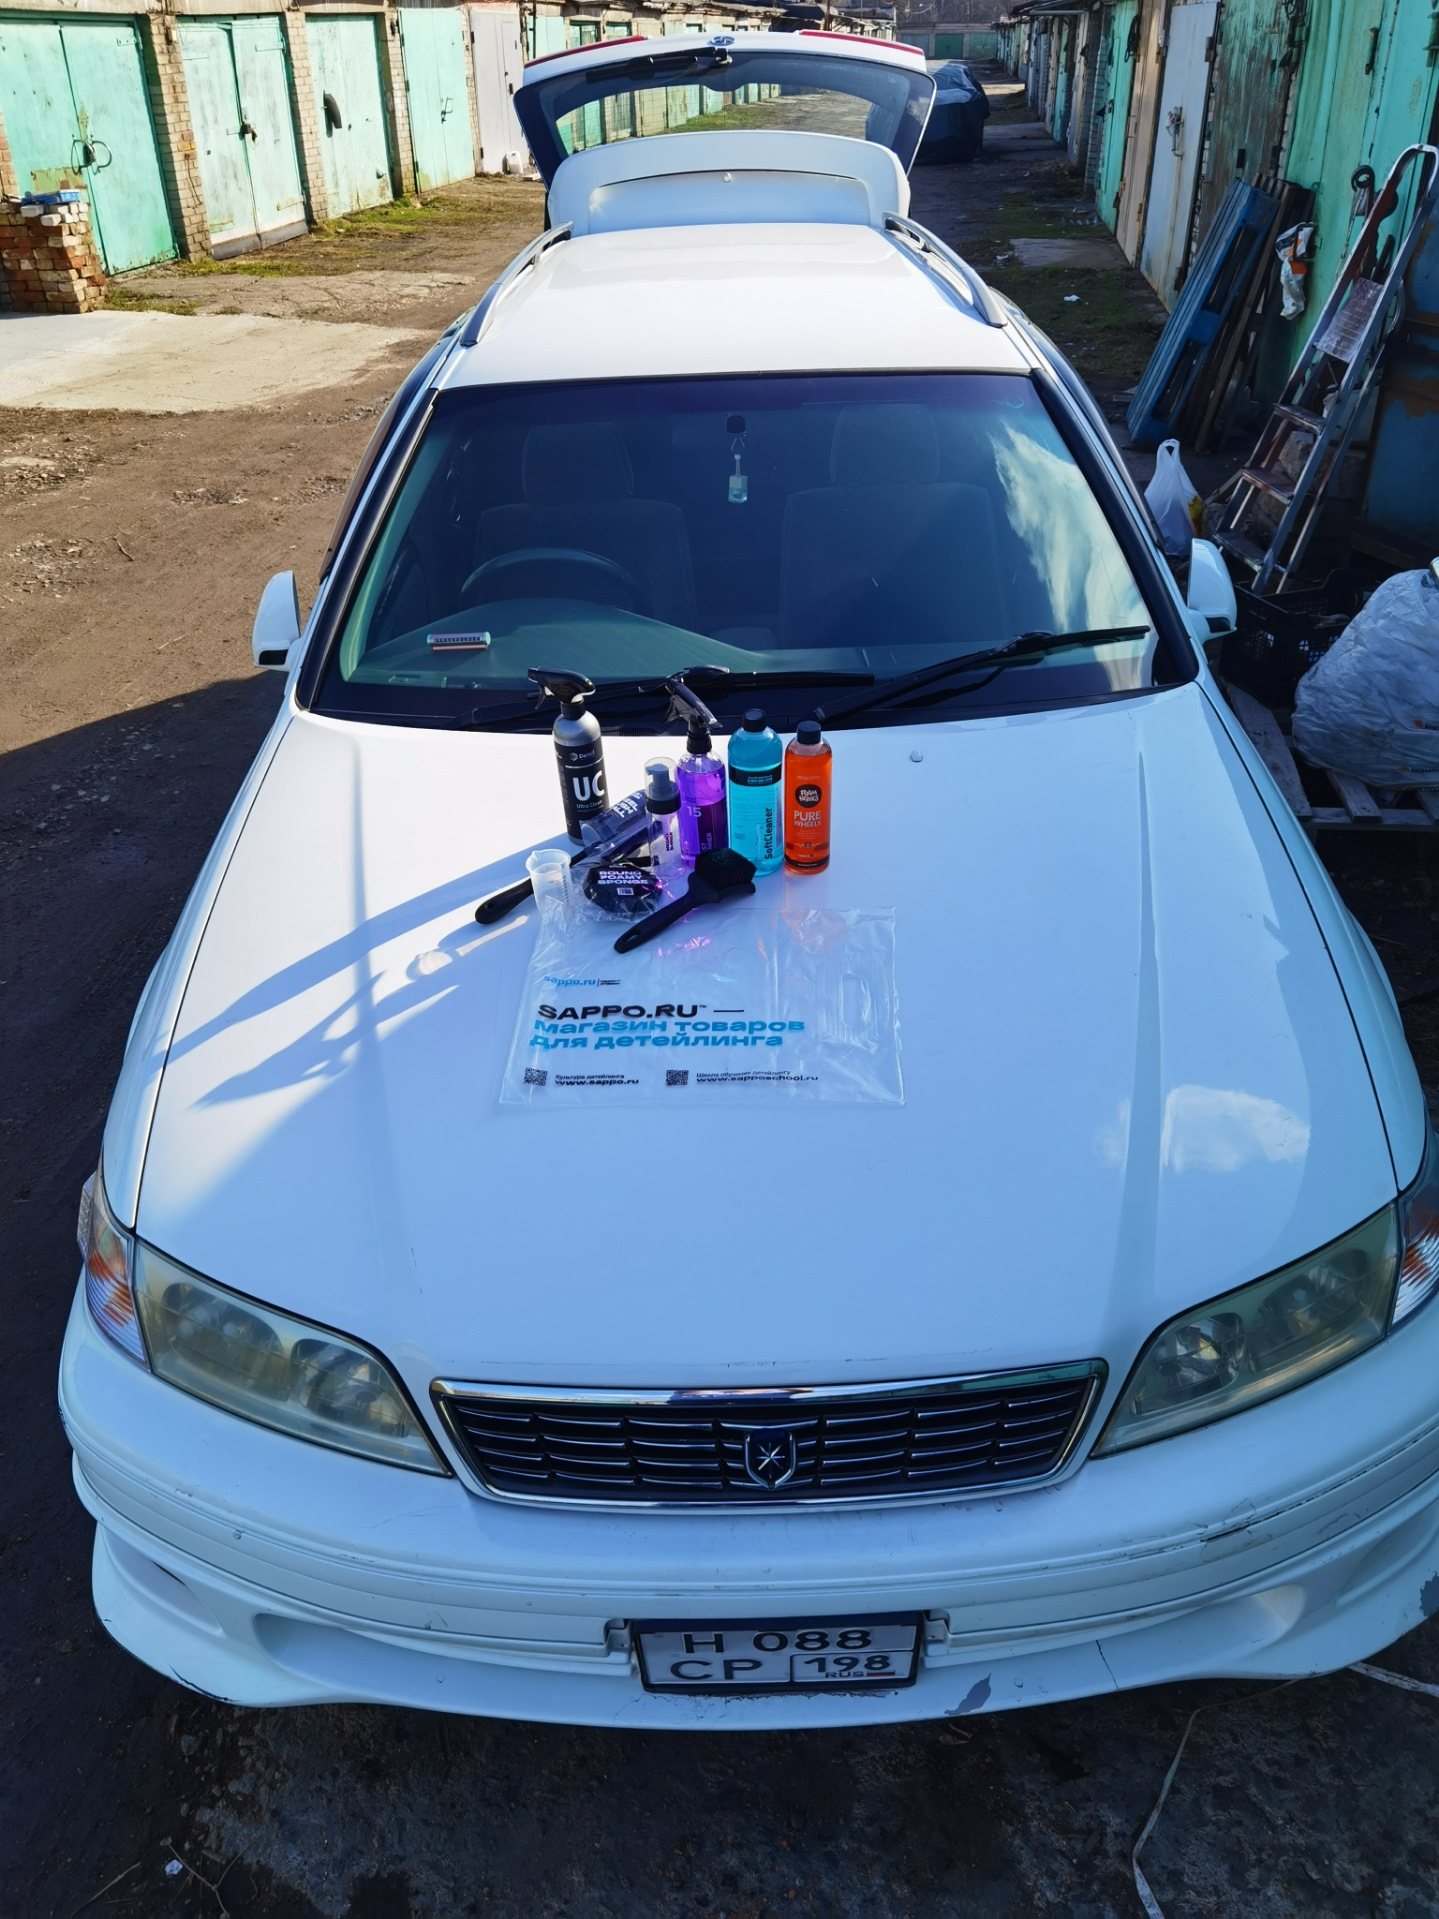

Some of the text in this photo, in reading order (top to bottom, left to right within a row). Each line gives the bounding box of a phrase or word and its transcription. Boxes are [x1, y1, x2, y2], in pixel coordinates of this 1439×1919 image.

[572, 770, 605, 801] UC
[686, 805, 702, 817] 15
[793, 809, 821, 821] PURE
[793, 819, 822, 828] WHEELS
[764, 807, 773, 860] SoftCleaner
[674, 1020, 805, 1035] товаров
[594, 1032, 784, 1050] детейлинга
[803, 1654, 891, 1674] 198
[825, 1670, 865, 1679] RUS
